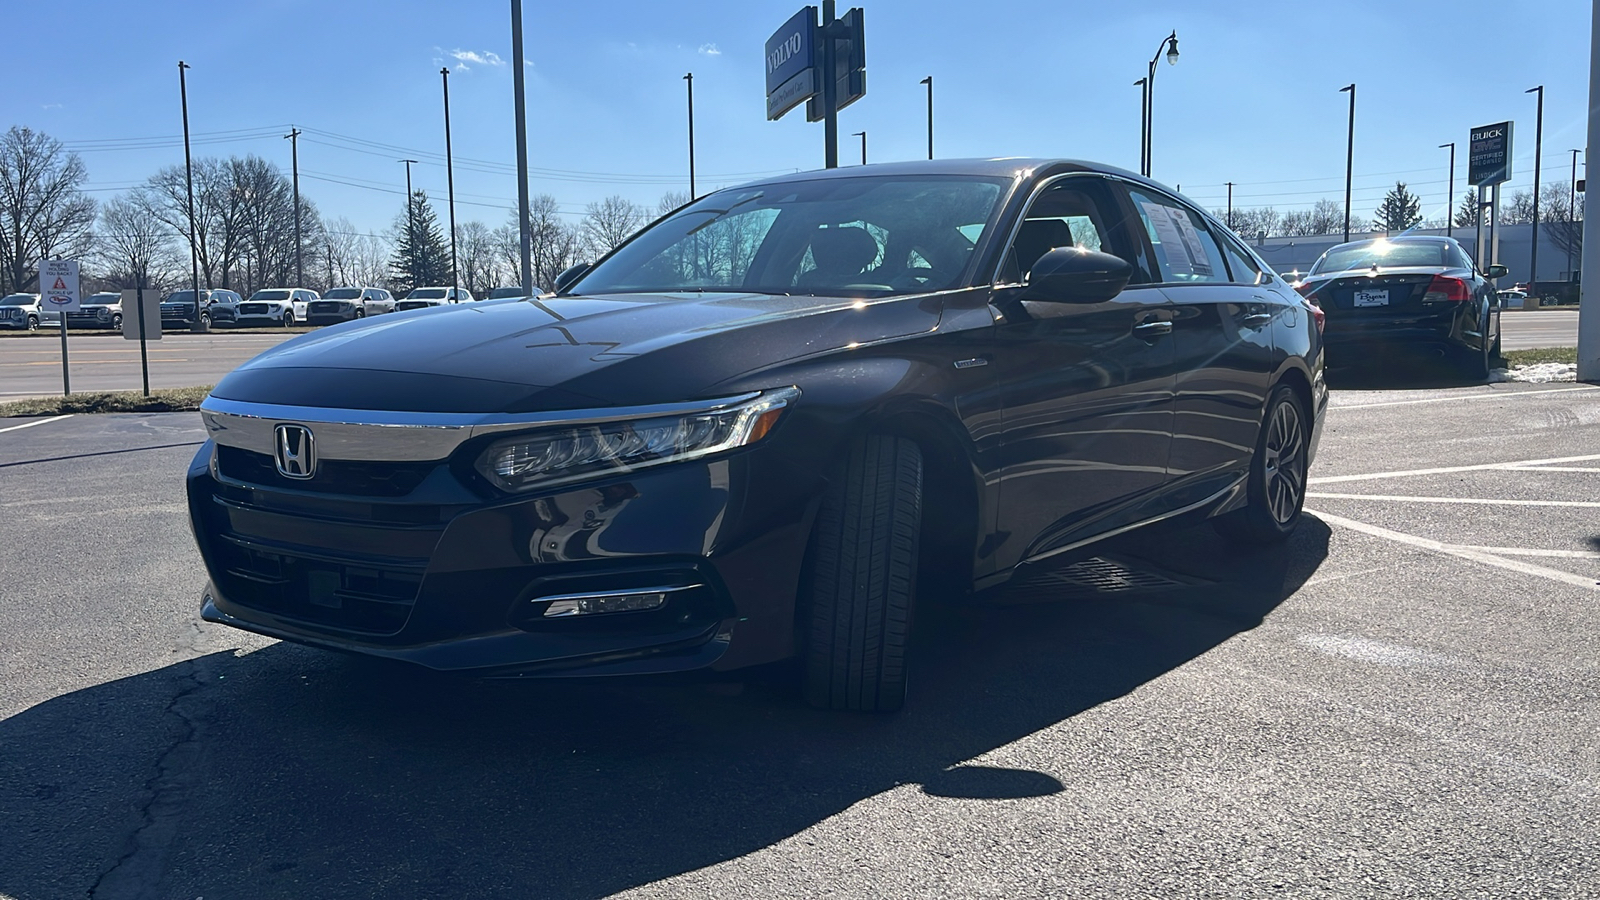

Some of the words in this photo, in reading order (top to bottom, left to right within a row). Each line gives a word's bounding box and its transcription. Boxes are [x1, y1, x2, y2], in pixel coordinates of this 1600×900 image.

[767, 32, 802, 74] VOLVO
[1471, 128, 1503, 141] BUICK
[1472, 138, 1502, 152] GMC
[1471, 151, 1504, 162] CERTIFIED
[1475, 171, 1498, 180] LINDSAY
